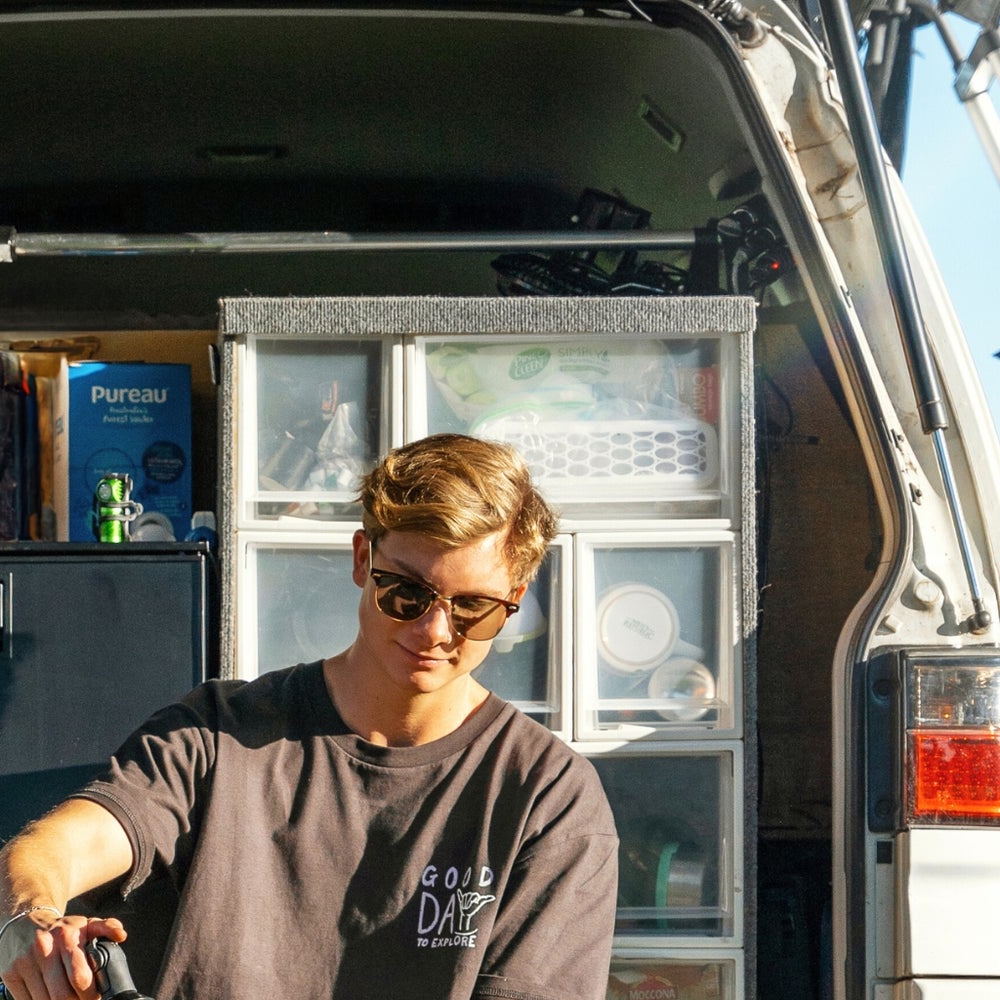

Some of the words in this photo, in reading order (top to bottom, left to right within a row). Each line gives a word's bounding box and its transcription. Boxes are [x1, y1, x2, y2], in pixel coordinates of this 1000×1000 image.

[558, 347, 602, 358] SIMPLY
[514, 359, 544, 377] CLEEN
[91, 385, 167, 404] Pureau
[421, 865, 494, 889] GOOD
[416, 937, 429, 948] TO
[431, 935, 477, 948] EXPLORE
[629, 989, 676, 1000] MOCCONA
